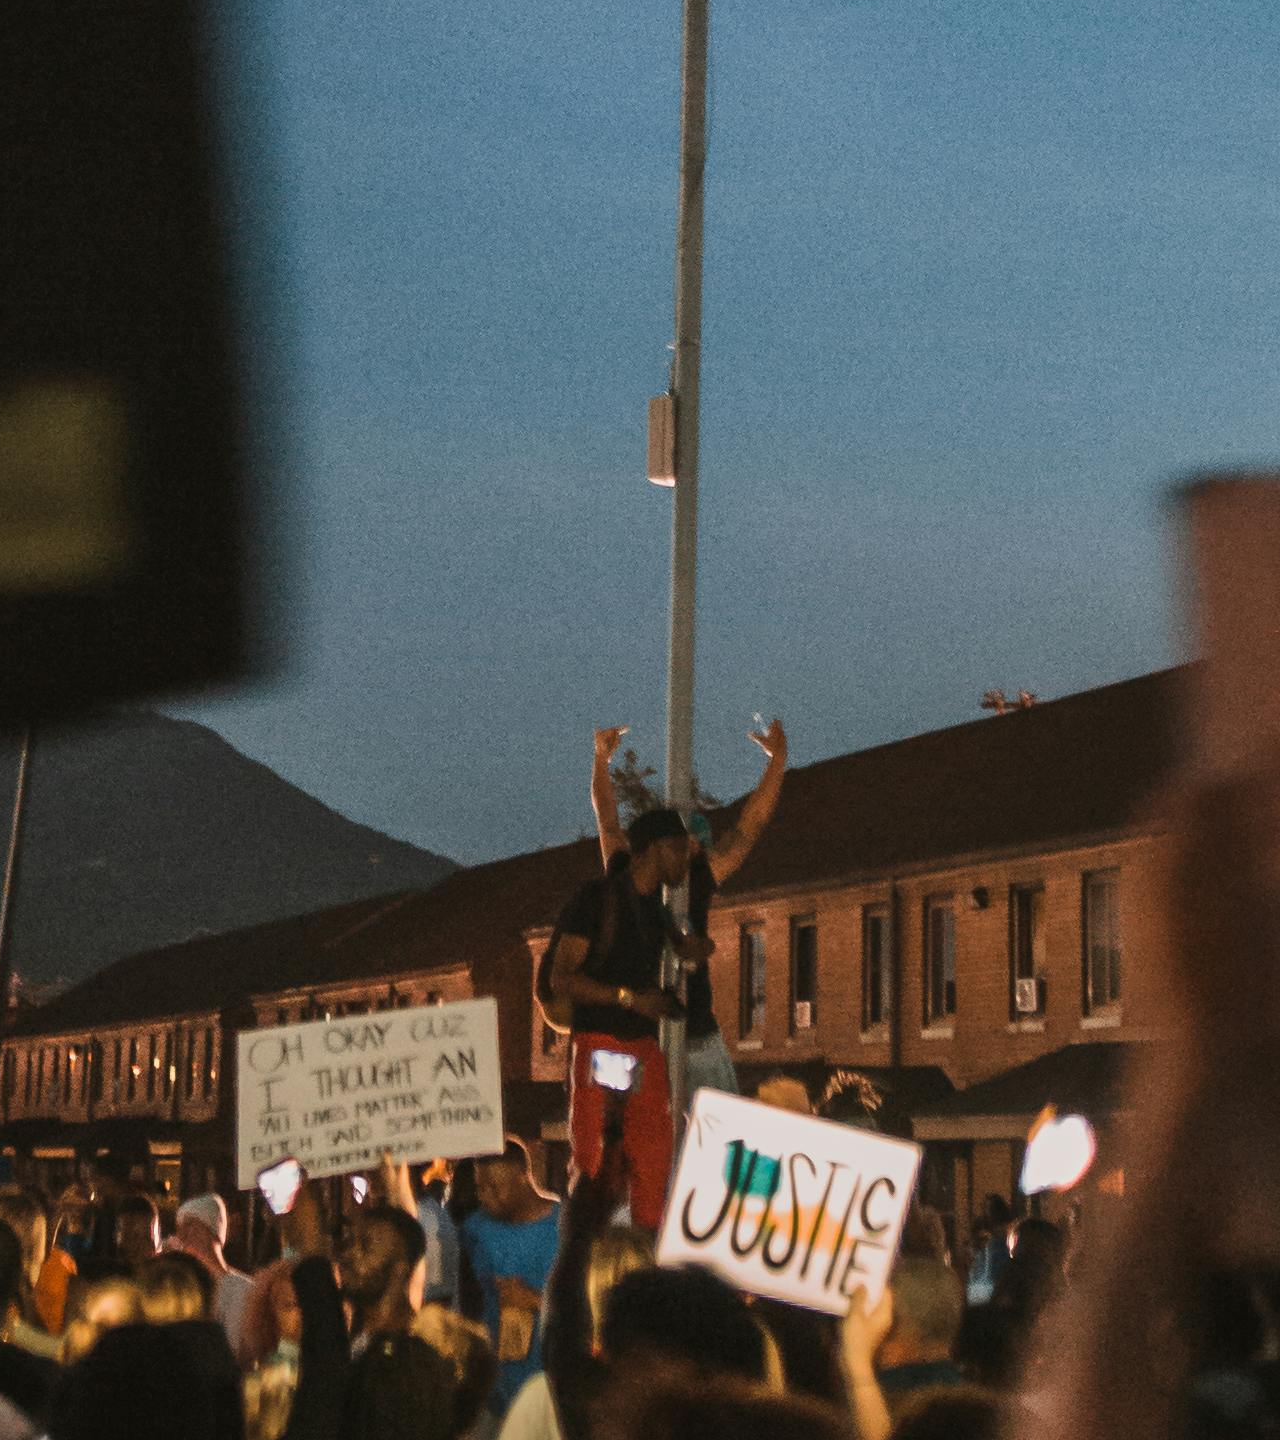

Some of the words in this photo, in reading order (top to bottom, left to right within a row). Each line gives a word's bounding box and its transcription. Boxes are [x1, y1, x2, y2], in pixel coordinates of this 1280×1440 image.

[248, 1034, 304, 1072] OH
[323, 1022, 392, 1054] OKAY
[258, 1076, 288, 1114] I
[311, 1055, 418, 1098] THOUGHT
[681, 1138, 897, 1298] JUSTICE
